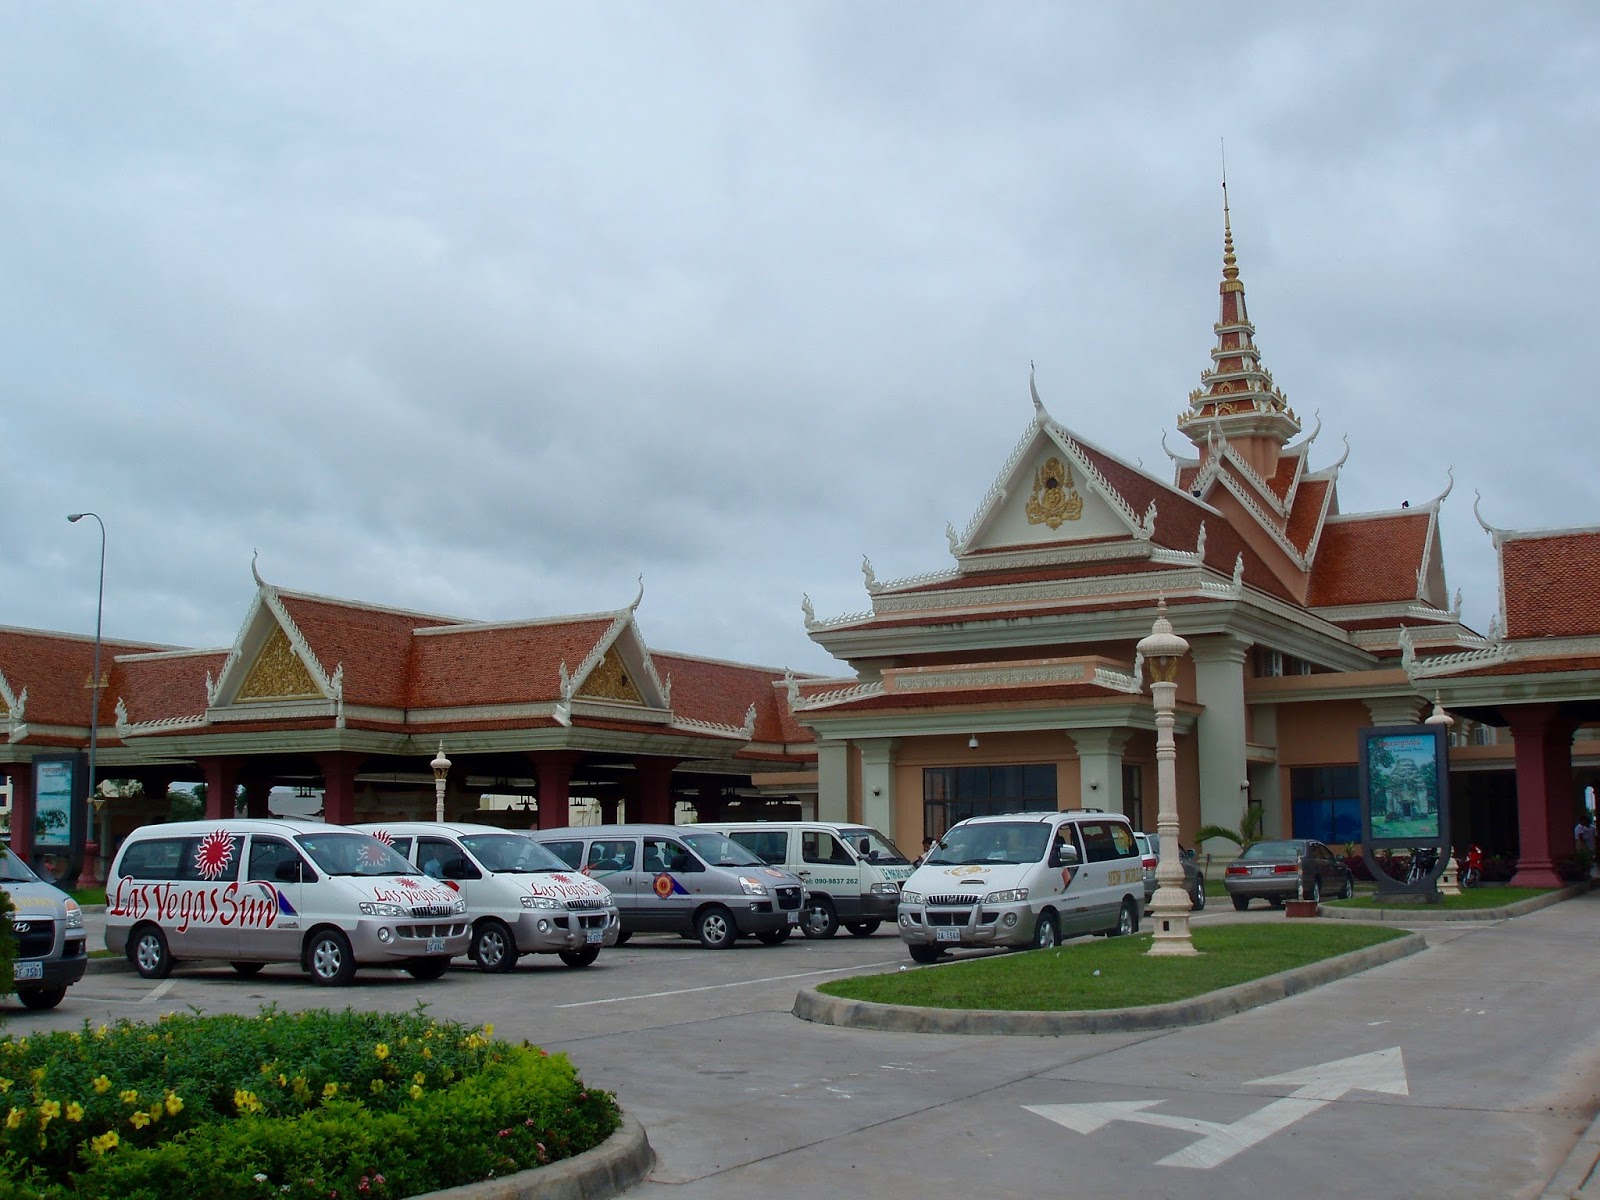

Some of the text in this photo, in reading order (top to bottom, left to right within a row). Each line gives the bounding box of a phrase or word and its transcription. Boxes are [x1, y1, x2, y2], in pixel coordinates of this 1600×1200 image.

[373, 886, 401, 903] Las
[400, 886, 441, 907] Vegas
[531, 882, 556, 898] Las
[554, 883, 590, 900] Vegas
[110, 875, 280, 934] Las Vegas Sun
